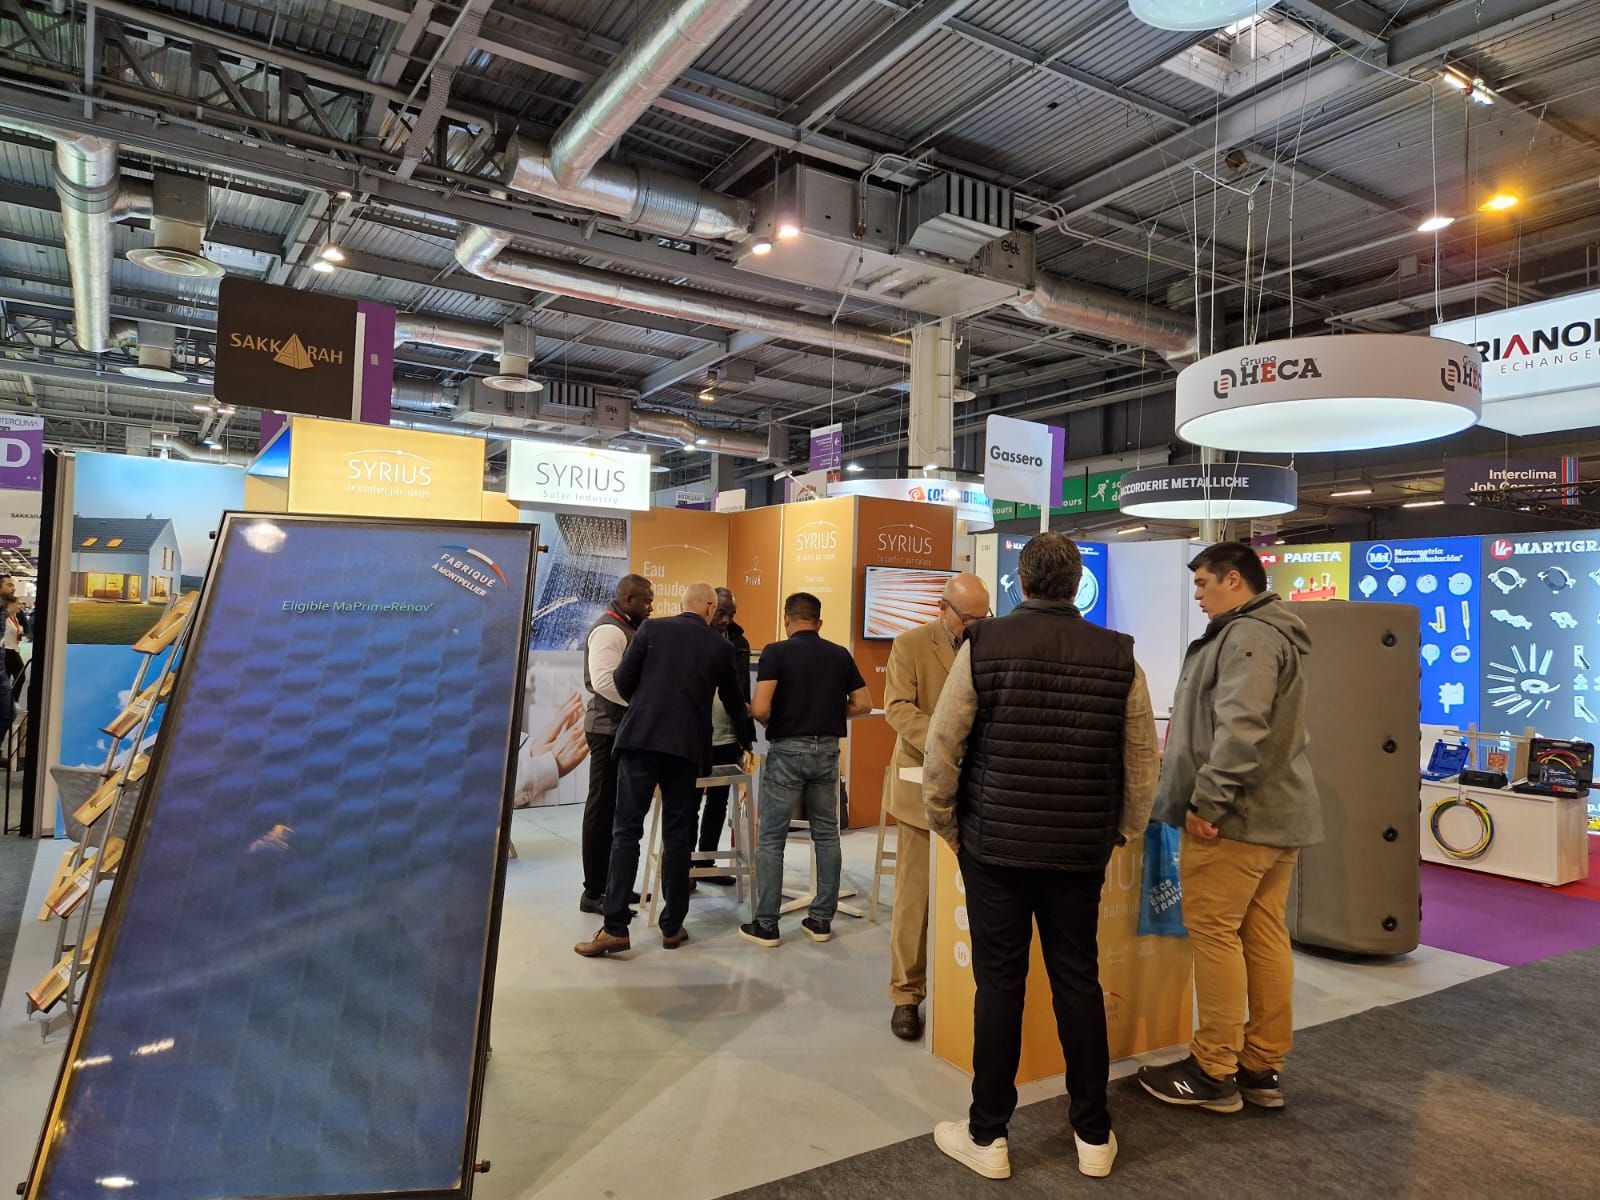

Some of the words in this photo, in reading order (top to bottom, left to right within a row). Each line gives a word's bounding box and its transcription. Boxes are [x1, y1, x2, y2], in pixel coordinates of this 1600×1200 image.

[229, 333, 343, 369] SAKKARAH
[1468, 318, 1600, 362] RIANO
[1240, 355, 1276, 366] Grupo
[1500, 349, 1600, 374] ECHANGE
[1240, 358, 1322, 386] HECA
[0, 417, 40, 427] TERCLIMA
[0, 437, 31, 467] D
[990, 445, 1043, 467] Gassero
[347, 458, 432, 486] SYRIUS
[535, 462, 626, 492] SYRIUS
[1171, 476, 1249, 489] METALLICHE
[1489, 468, 1557, 480] Interclima
[543, 489, 571, 500] Solar
[1063, 498, 1082, 507] ours
[797, 531, 838, 551] SYRIUS
[877, 533, 933, 555] SYRIUS
[1284, 551, 1342, 563] PARETA
[440, 553, 496, 588] FABRIQUÉ
[643, 560, 665, 578] Eau
[438, 566, 487, 597] MONTPELLIER
[282, 600, 329, 614] Eligible
